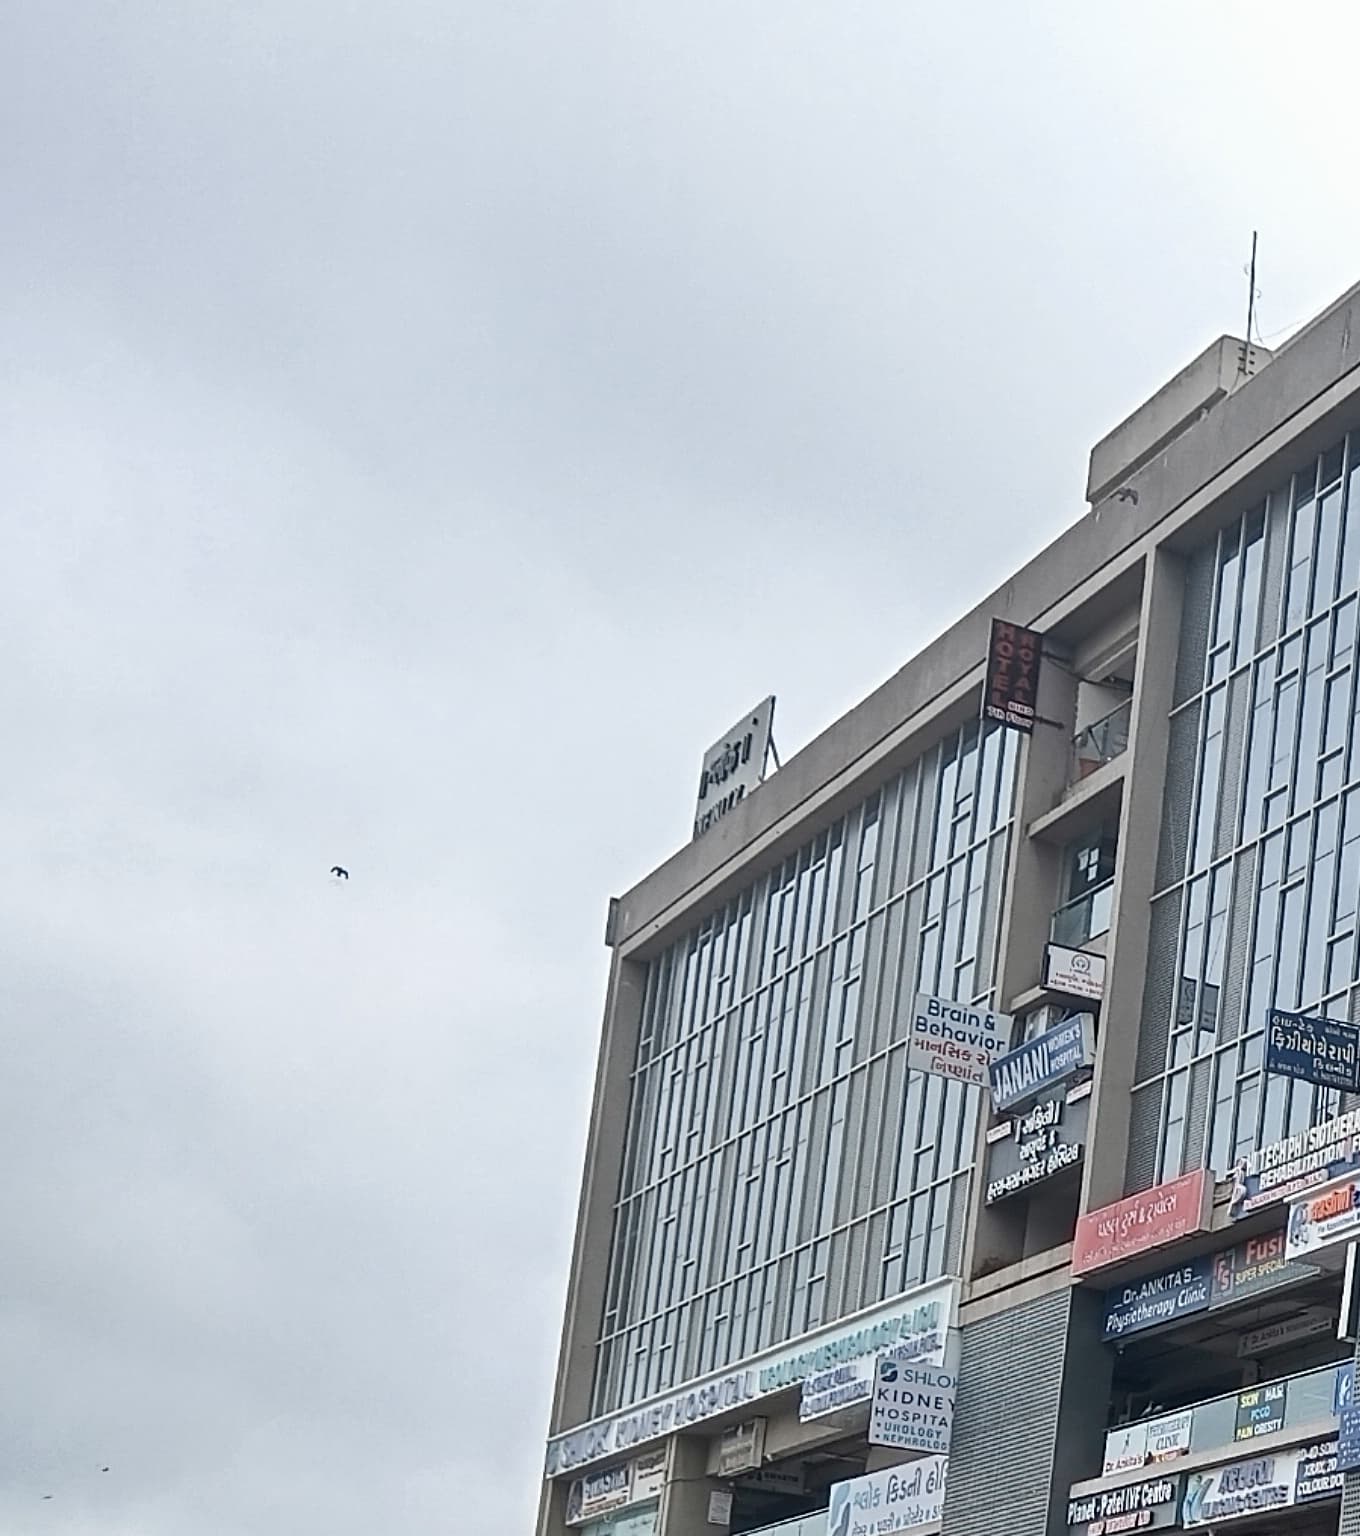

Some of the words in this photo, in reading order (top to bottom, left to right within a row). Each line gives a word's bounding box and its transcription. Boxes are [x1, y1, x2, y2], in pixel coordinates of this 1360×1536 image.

[914, 1015, 1006, 1052] Behavior
[927, 999, 980, 1028] Brain
[983, 1013, 996, 1031] &
[993, 1042, 1050, 1103] JANANI
[1105, 1297, 1176, 1333] Physiotherapy
[1178, 1283, 1207, 1308] Clinic
[884, 1422, 942, 1440] UROLOGY
